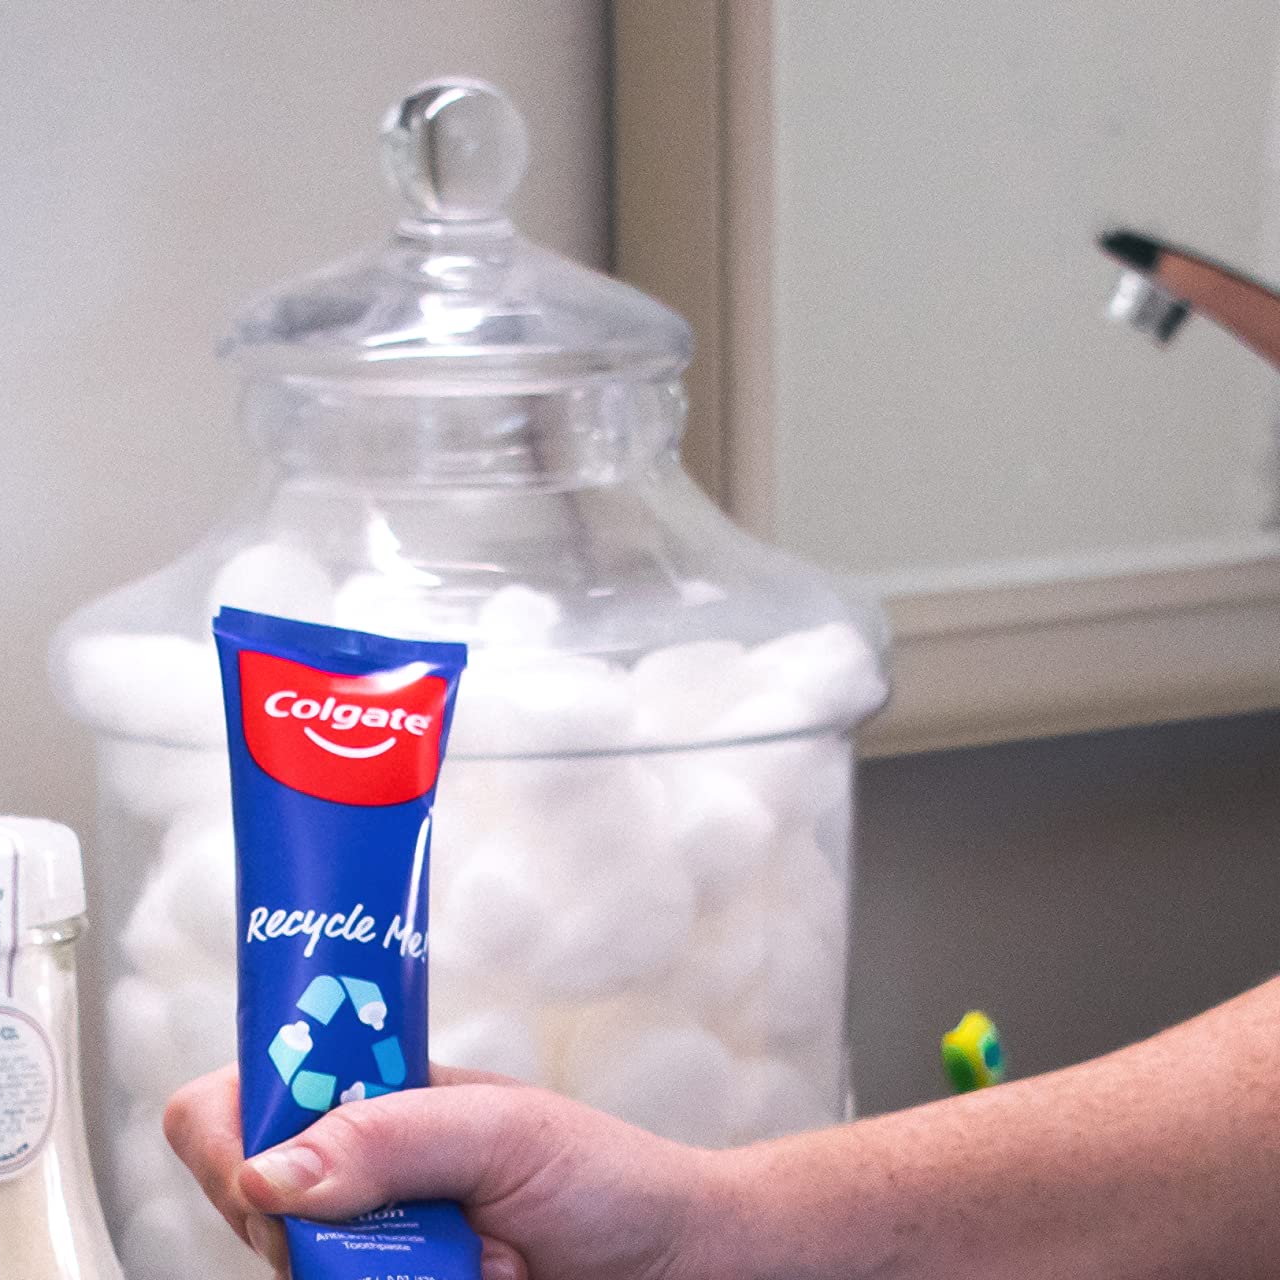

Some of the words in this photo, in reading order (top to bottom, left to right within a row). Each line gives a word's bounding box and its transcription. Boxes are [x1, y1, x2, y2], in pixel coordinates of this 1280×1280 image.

[264, 690, 430, 736] Colgate
[247, 903, 376, 958] Recycle
[382, 914, 428, 963] Me!
